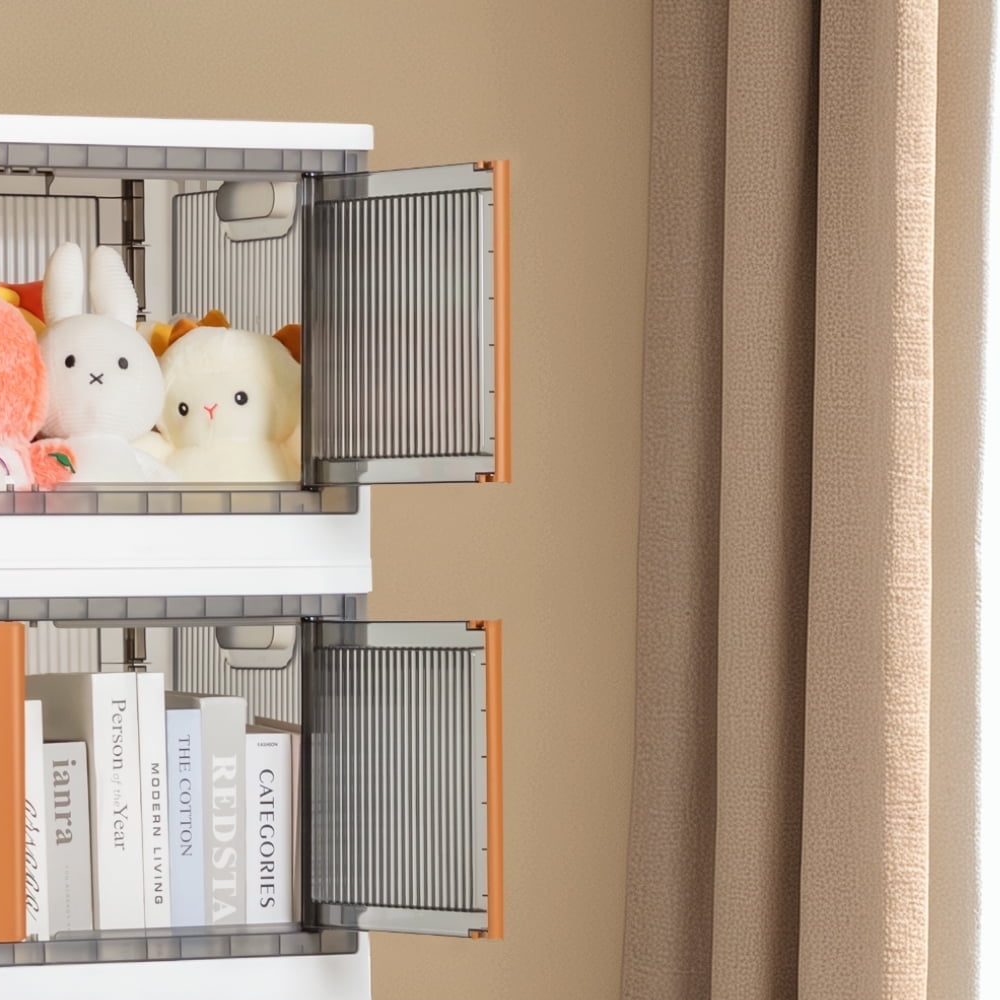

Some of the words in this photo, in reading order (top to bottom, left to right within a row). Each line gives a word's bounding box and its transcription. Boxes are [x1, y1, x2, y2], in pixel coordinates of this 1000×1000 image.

[111, 699, 127, 770] Person
[178, 734, 191, 773] THE
[52, 758, 77, 846] ianra
[111, 772, 122, 785] of
[112, 787, 122, 807] the
[151, 762, 162, 837] MODERN
[113, 803, 129, 851] Year
[178, 777, 193, 857] COTTON
[212, 753, 238, 923] REDSTA
[258, 768, 276, 908] CATEGORIES
[153, 846, 164, 905] LIVING
